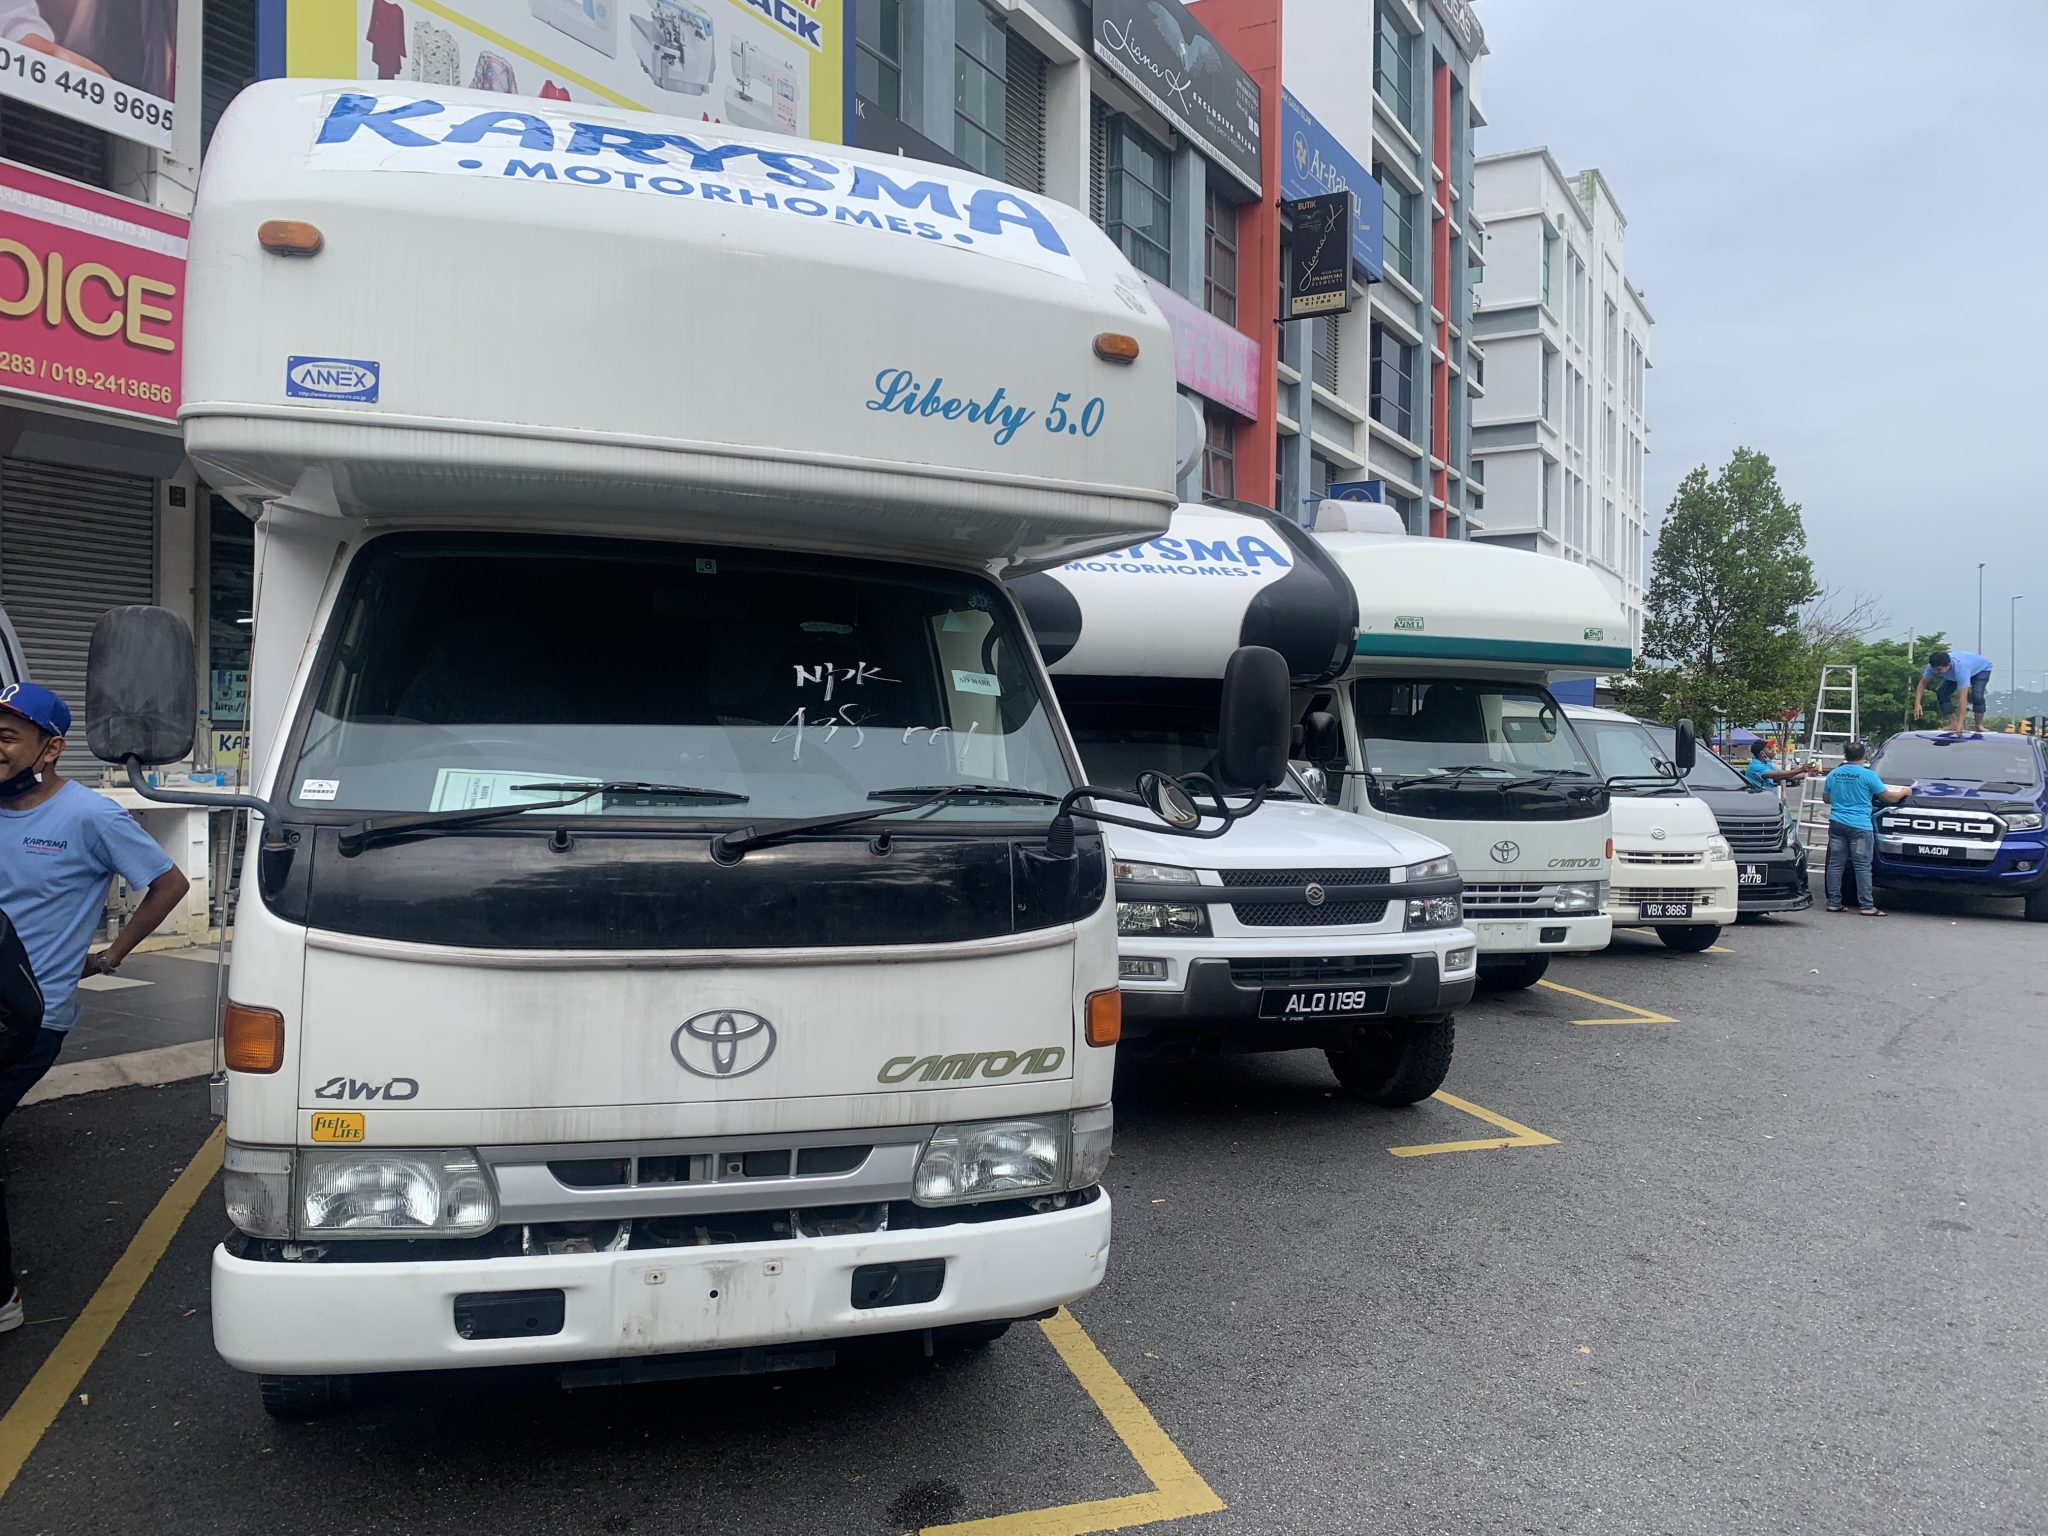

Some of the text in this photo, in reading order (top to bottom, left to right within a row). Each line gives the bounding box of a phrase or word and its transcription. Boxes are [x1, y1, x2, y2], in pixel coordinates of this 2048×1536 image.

[55, 71, 105, 104] 449
[113, 94, 173, 131] 9695
[1193, 91, 1234, 133] EXCLUSIVE
[315, 92, 1071, 257] KARYSMA
[503, 158, 943, 241] MOTORHOMES
[1298, 200, 1317, 210] BUTIK
[1294, 292, 1343, 304] EXCLUSIVE
[0, 351, 36, 376] 283
[51, 362, 173, 404] 019-2413656
[300, 368, 367, 388] ANNEX
[866, 368, 1105, 446] Liberty 5.0
[1882, 817, 1994, 834] FORD
[23, 836, 68, 849] KARYSMA
[1547, 857, 1600, 868] CAMROAD
[1647, 904, 1687, 916] VBX 3665
[1285, 991, 1366, 1012] ALQ 1199
[877, 1046, 1066, 1084] CAMROAD
[315, 1077, 419, 1100] 4WD
